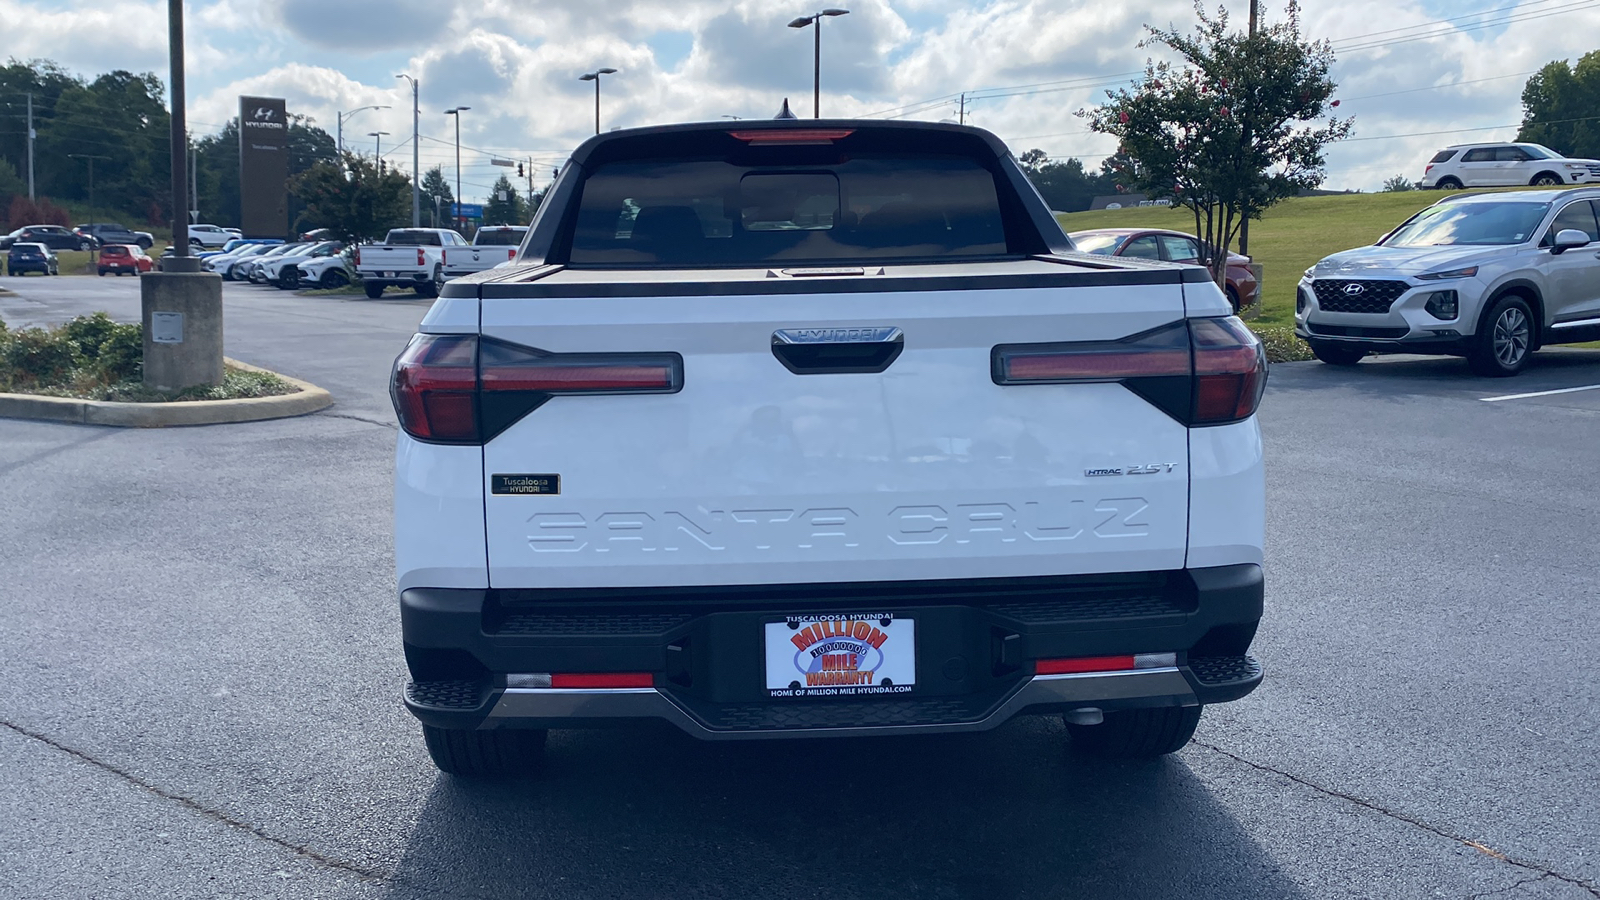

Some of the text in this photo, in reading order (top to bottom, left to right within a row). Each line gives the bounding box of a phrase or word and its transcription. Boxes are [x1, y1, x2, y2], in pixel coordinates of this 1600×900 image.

[245, 121, 283, 129] HYUNDAI
[798, 328, 878, 342] HYUNDAI
[1088, 468, 1121, 476] HTRAC
[503, 477, 548, 486] Tuscaloosa
[526, 497, 1149, 552] SANTA CRUZ
[786, 613, 894, 623] TUSCALOOSA HYUNDAI
[790, 619, 889, 652] MILLION
[822, 653, 858, 672] MILE
[806, 670, 875, 687] WARRANTY
[795, 689, 806, 697] OF
[807, 688, 838, 696] MILLION
[839, 687, 856, 695] MILE
[857, 685, 912, 695] HYUNDAI.COM
